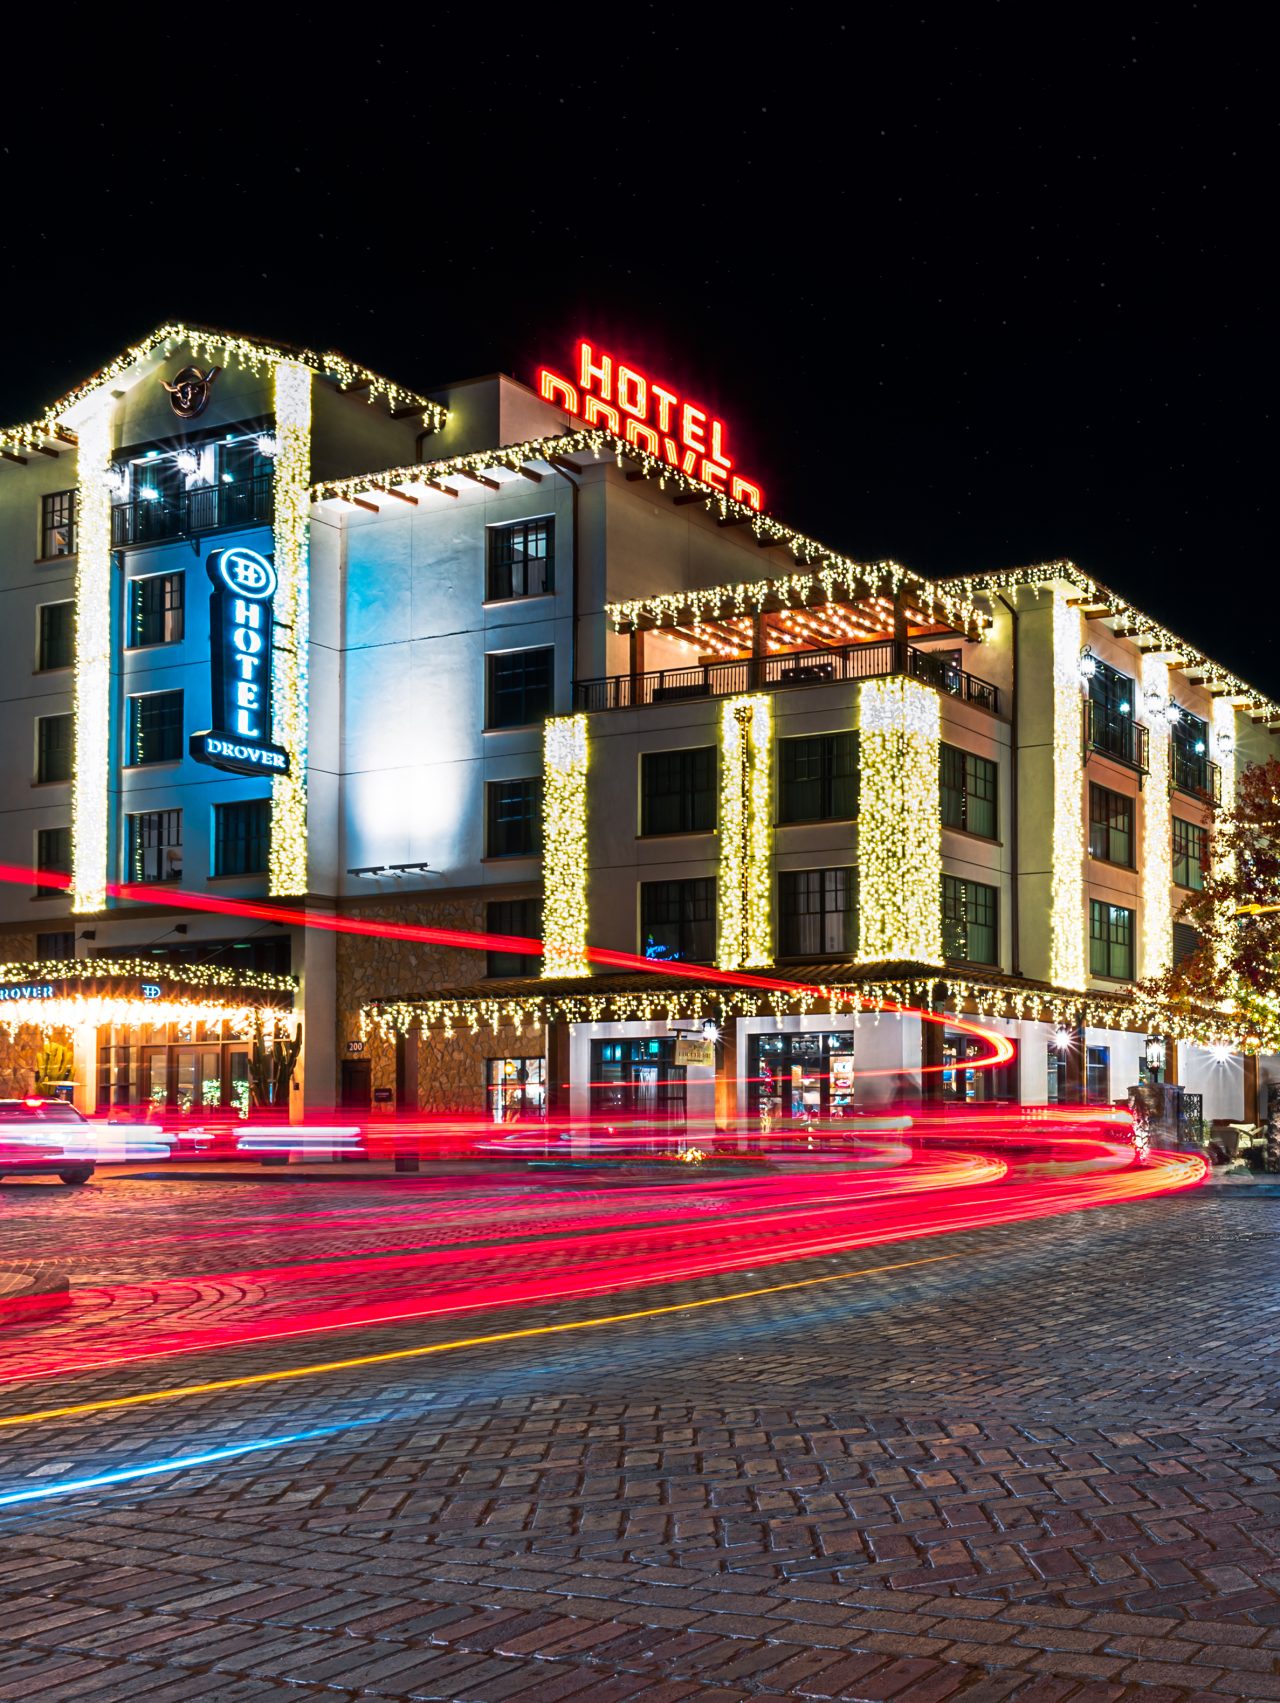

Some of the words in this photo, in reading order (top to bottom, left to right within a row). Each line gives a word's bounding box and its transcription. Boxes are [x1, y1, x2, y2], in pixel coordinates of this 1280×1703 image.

[579, 342, 732, 469] HOTEL
[233, 598, 262, 737] HOTEL
[206, 737, 287, 768] DROVER
[0, 986, 53, 1000] ROVER
[349, 1042, 363, 1051] 200
